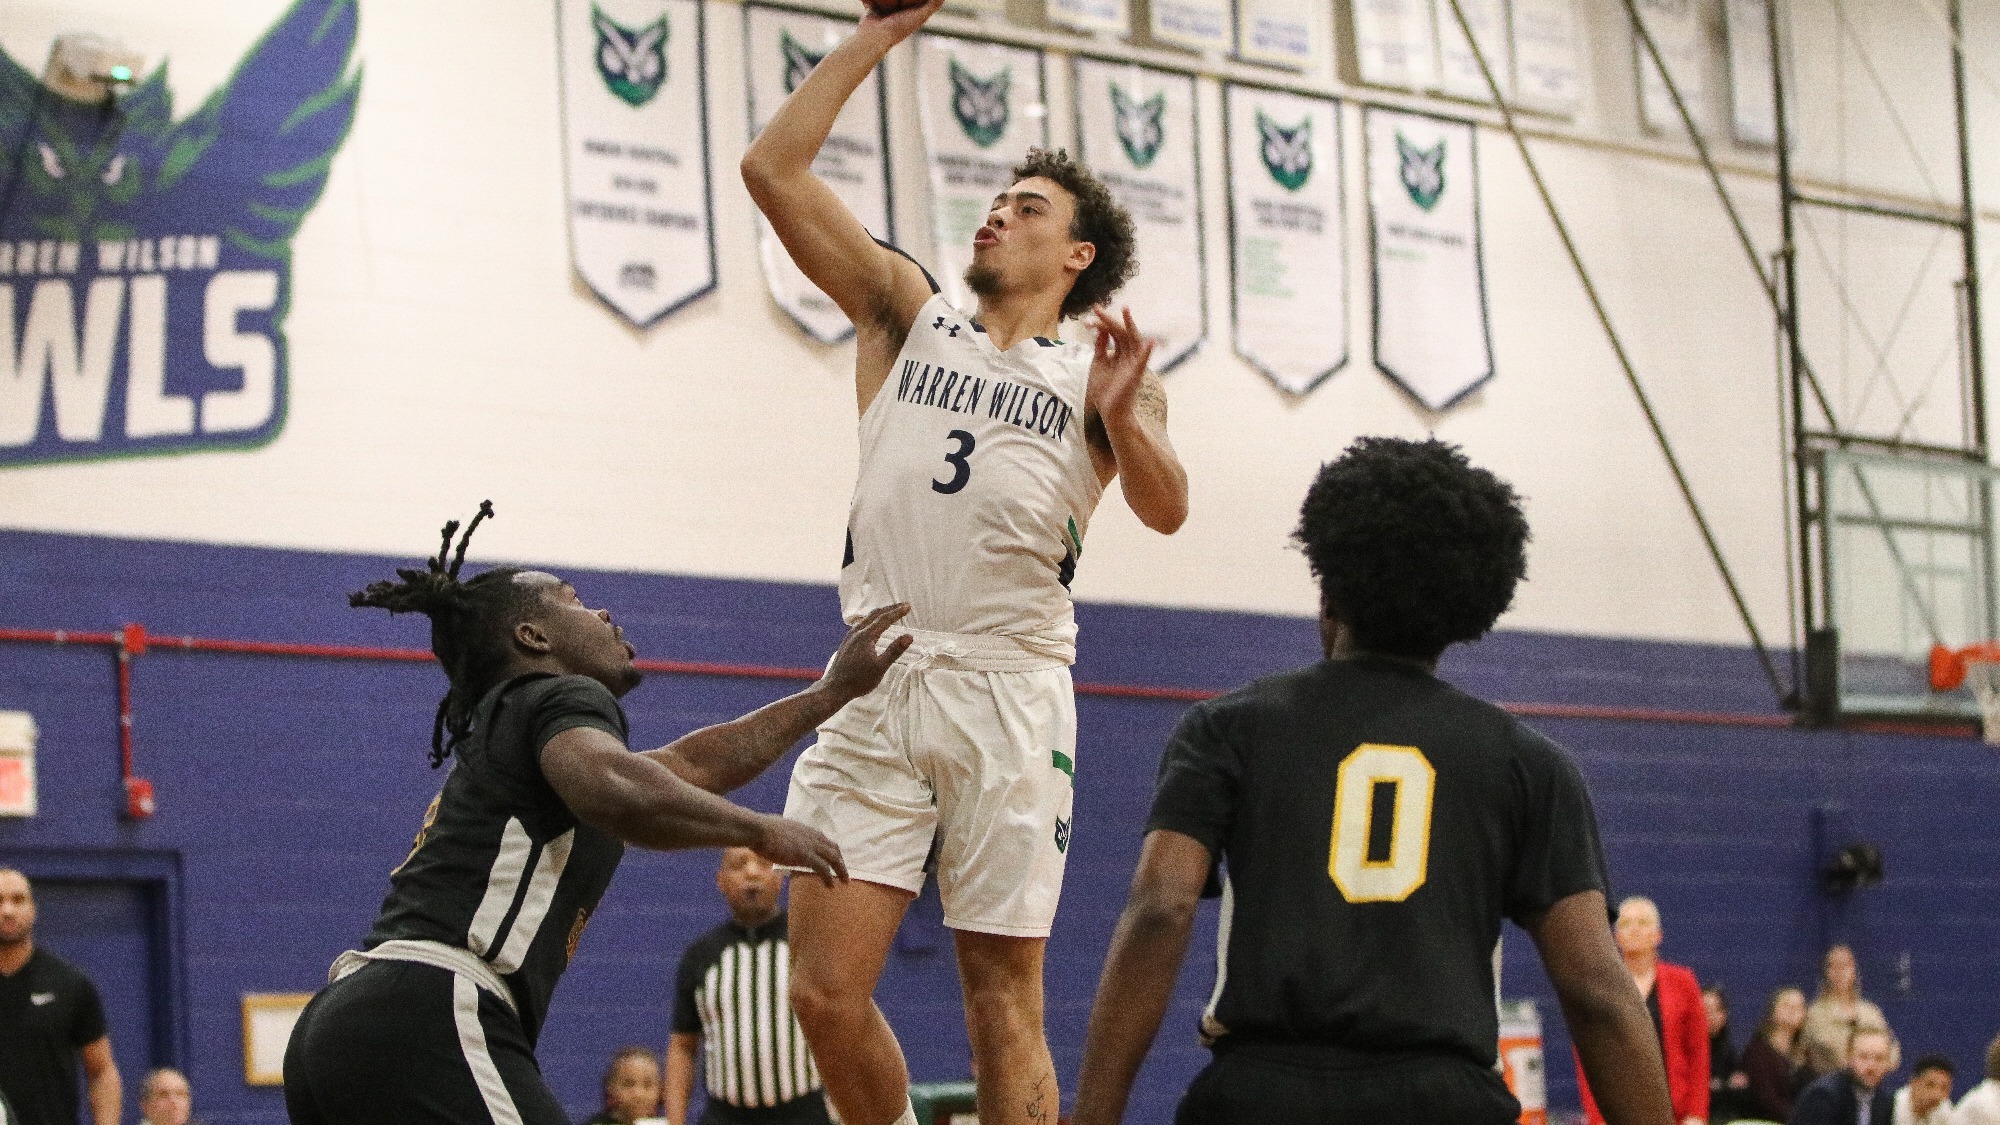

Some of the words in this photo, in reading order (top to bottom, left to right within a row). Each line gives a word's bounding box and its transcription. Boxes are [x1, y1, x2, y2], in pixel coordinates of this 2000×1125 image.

[98, 235, 219, 271] WILSON
[0, 270, 278, 447] WLS
[898, 359, 987, 415] WARREN
[988, 381, 1073, 442] WILSON
[931, 429, 976, 494] 3
[1328, 742, 1437, 903] 0
